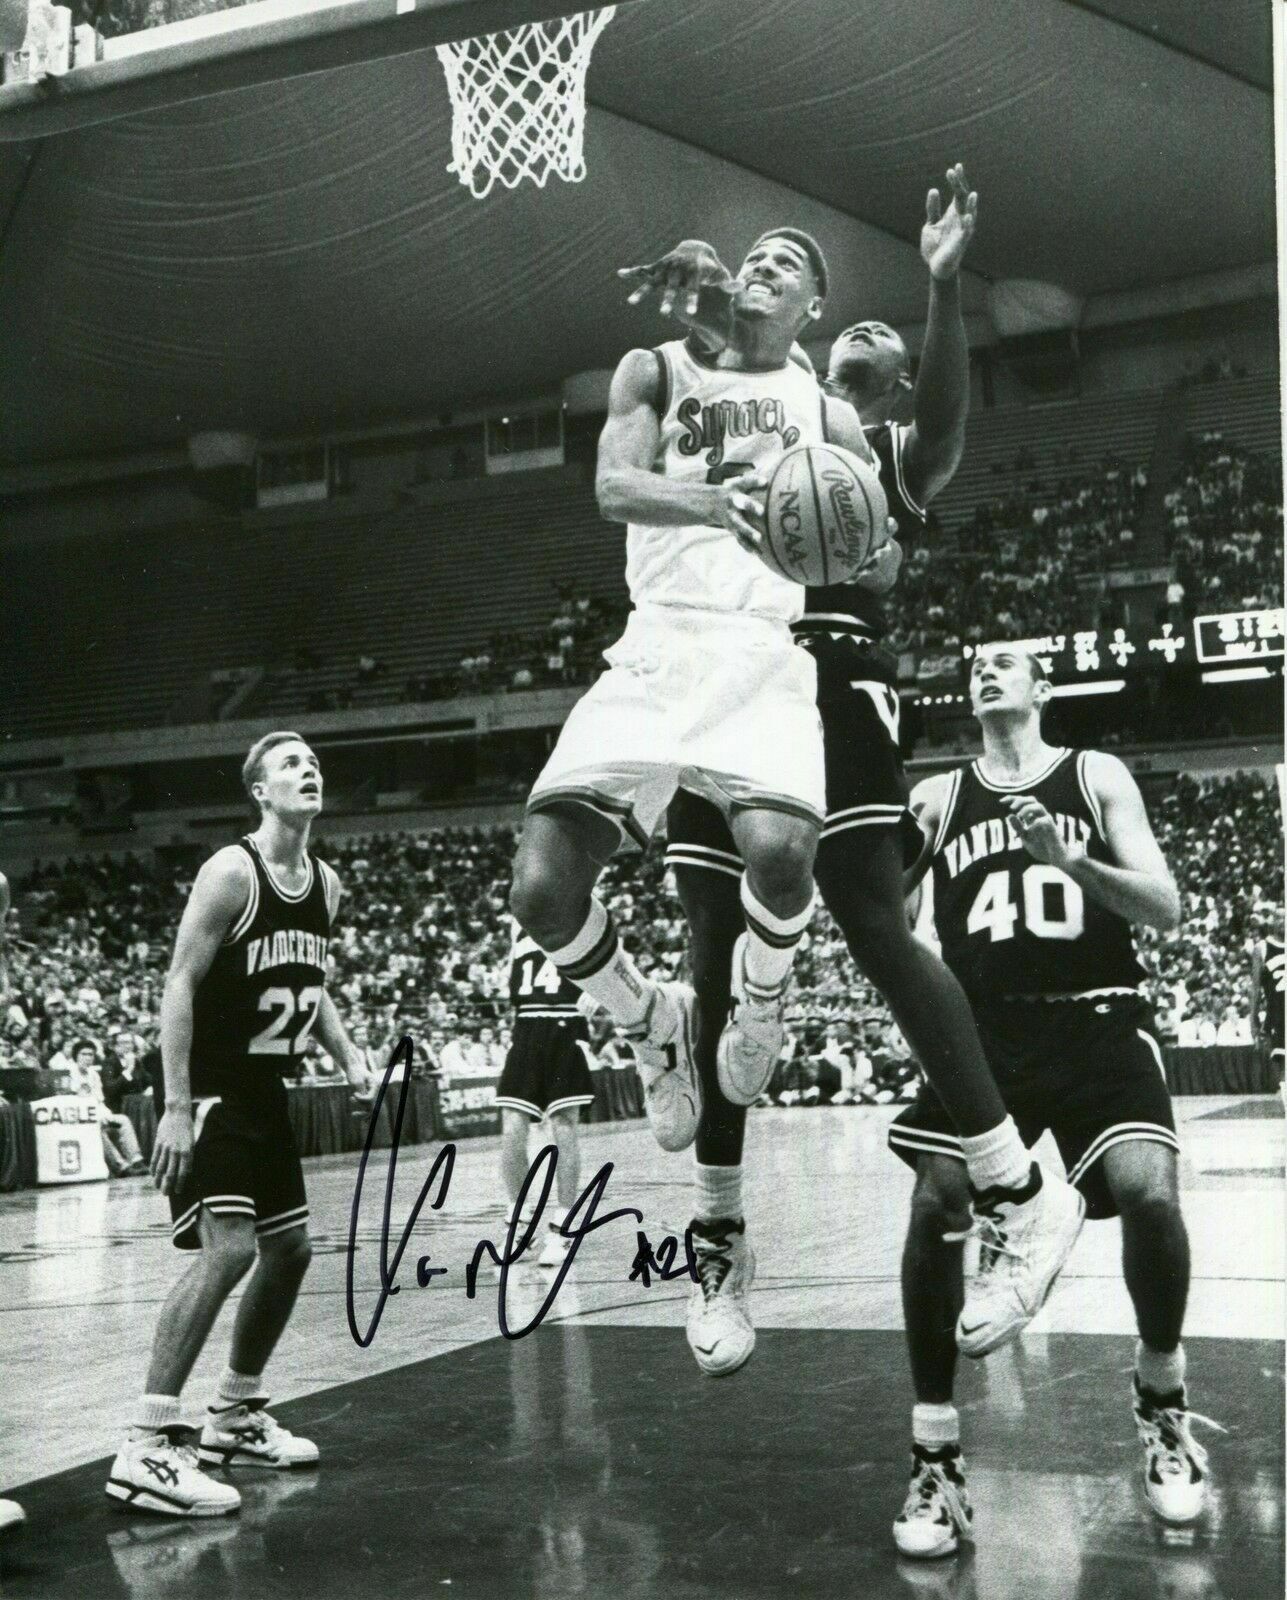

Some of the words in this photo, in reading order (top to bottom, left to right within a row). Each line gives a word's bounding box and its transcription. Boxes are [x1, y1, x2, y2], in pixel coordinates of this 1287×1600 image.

[677, 397, 800, 466] Syrac
[779, 488, 808, 567] NCAA
[943, 812, 1092, 879] VANDEILT
[966, 864, 1085, 943] 40
[247, 929, 328, 976] VANDERBIL
[517, 959, 562, 996] 14
[247, 986, 324, 1055] 22
